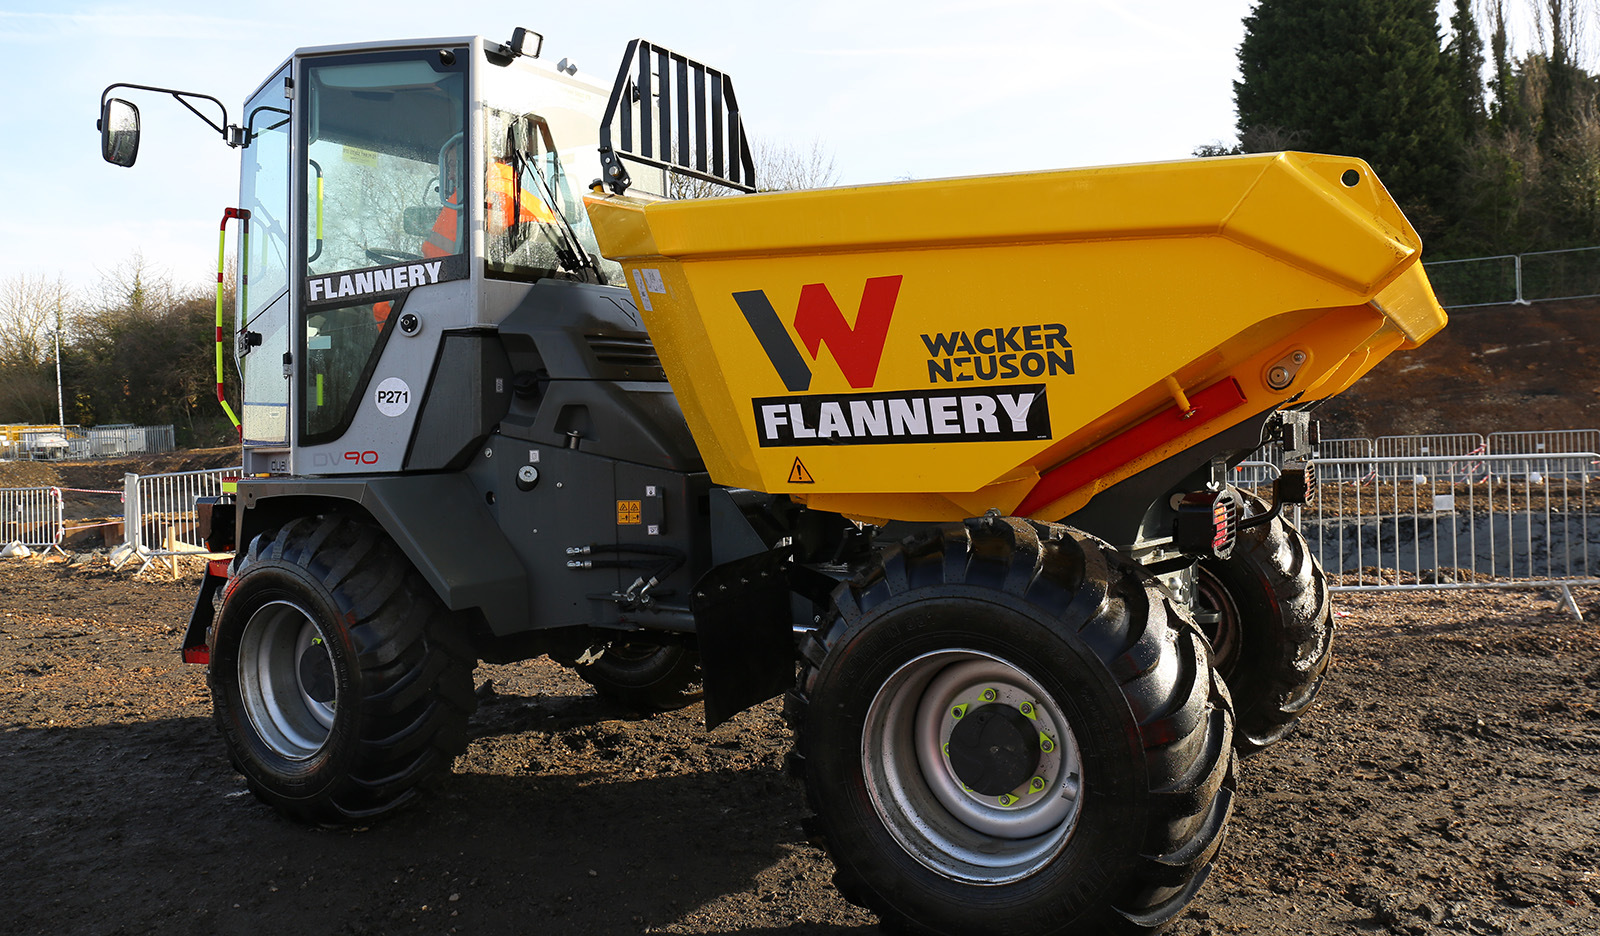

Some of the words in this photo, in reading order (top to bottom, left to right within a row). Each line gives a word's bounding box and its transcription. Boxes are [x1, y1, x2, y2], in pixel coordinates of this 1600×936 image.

[309, 261, 442, 301] FLANNERY
[920, 323, 1072, 357] WACKER
[927, 350, 1075, 383] NEUSON
[378, 391, 408, 404] P271
[761, 393, 1035, 439] FLANNERY
[312, 450, 379, 467] DV90
